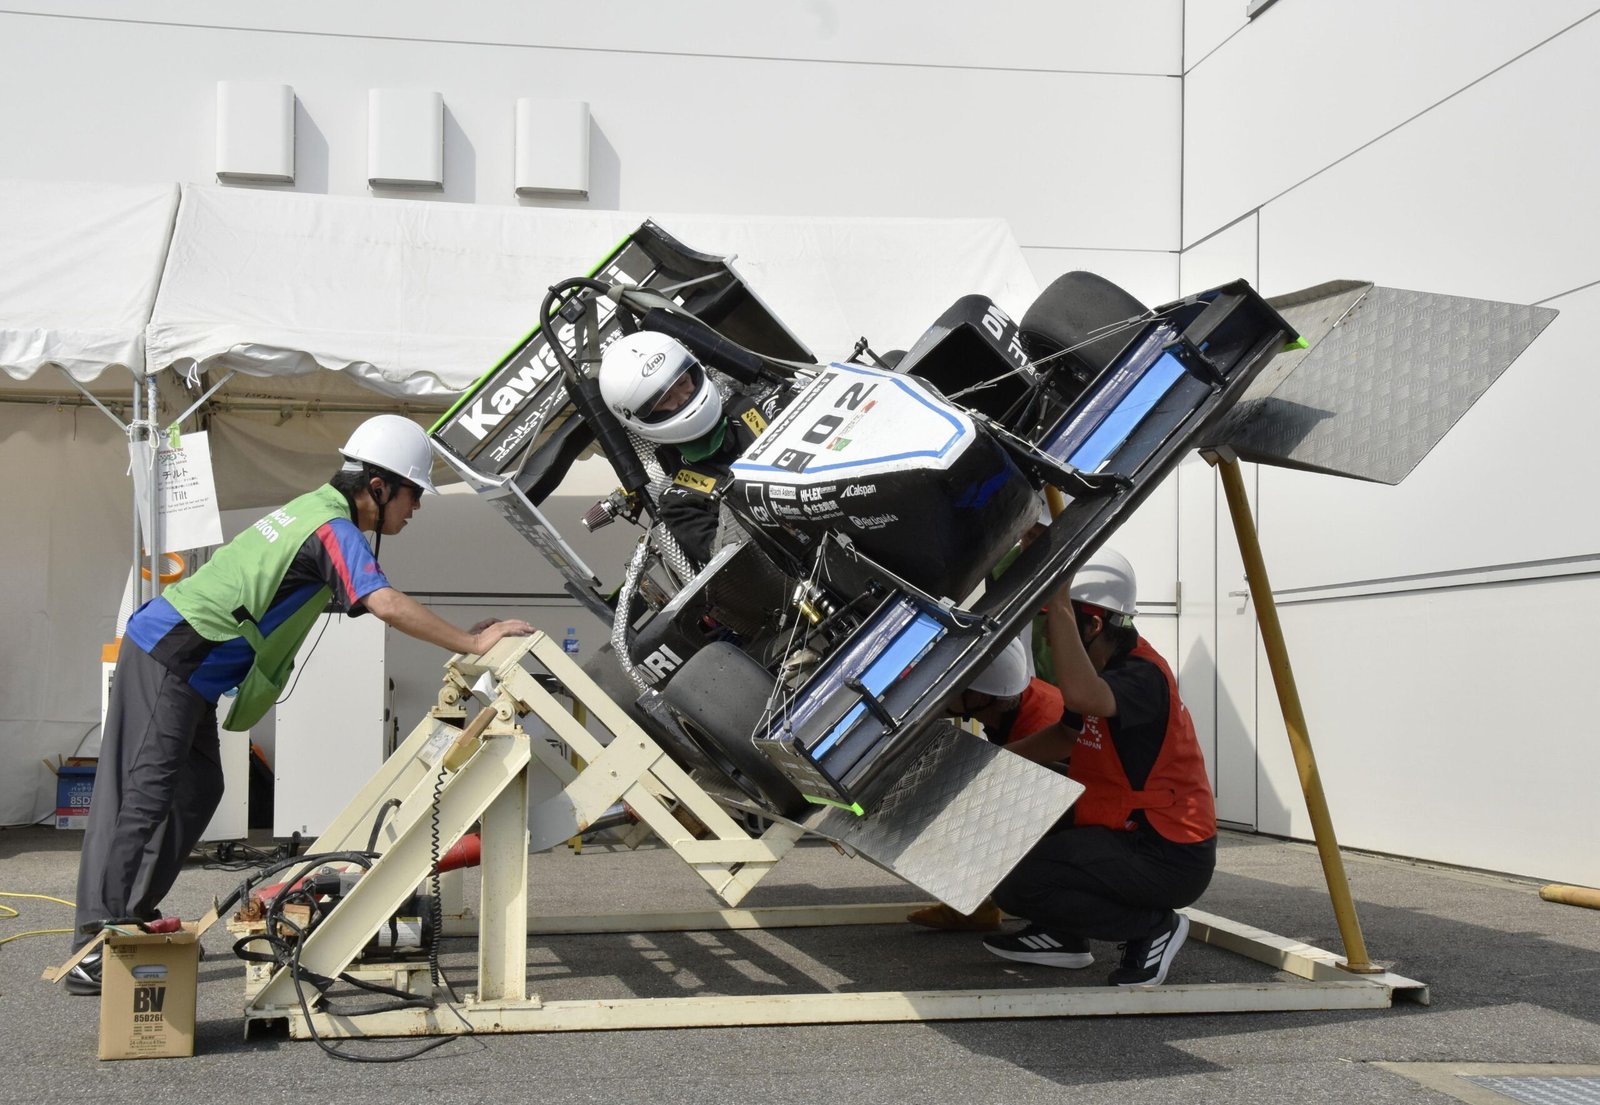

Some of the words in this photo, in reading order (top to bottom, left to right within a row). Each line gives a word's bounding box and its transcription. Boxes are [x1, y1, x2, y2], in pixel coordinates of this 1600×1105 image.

[643, 354, 664, 376] Arai
[802, 382, 879, 444] 02
[162, 467, 188, 480] チルト
[173, 491, 187, 501] Tilt
[849, 484, 876, 497] Calspan
[133, 986, 166, 1013] BV
